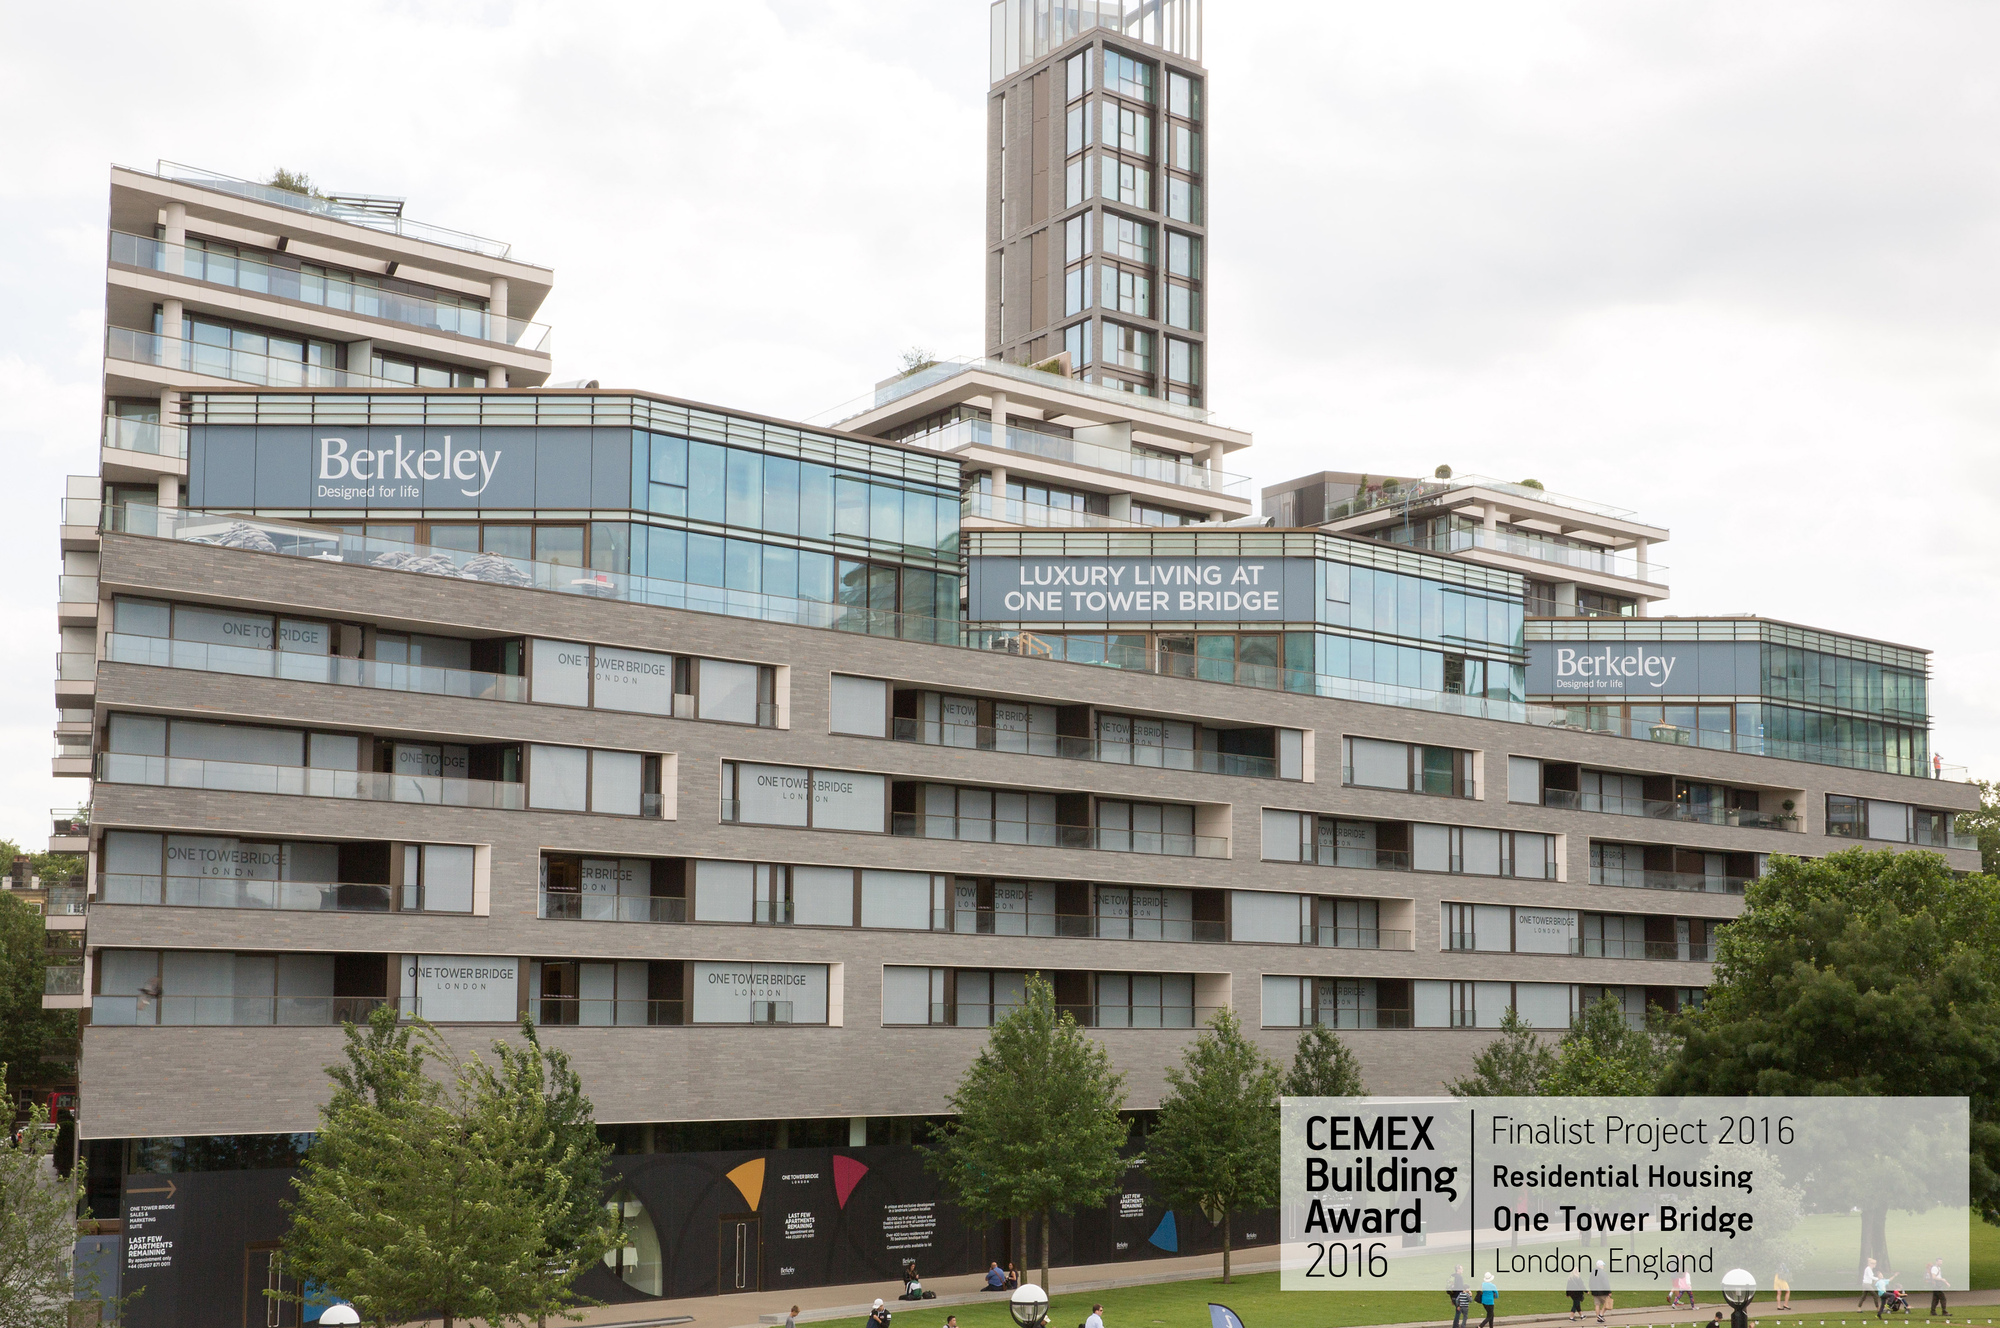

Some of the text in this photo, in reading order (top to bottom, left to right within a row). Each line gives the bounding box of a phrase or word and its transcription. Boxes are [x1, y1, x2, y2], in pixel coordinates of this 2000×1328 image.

[319, 435, 502, 497] Berkeley
[318, 485, 420, 500] Designed for life
[1020, 565, 1264, 585] LUXURY LIVING AT
[1004, 591, 1279, 611] ONE TOWER BRIDGE
[223, 622, 251, 637] ONE
[558, 653, 581, 666] ONE
[627, 661, 665, 676] BRIDGE
[1557, 646, 1676, 687] Berkeley
[1557, 679, 1623, 689] Designed for life
[400, 752, 422, 763] ONE
[757, 775, 778, 787] ONE
[818, 781, 852, 793] BRIDGE
[167, 847, 195, 860] ONE
[241, 852, 286, 865] BRIDGE
[595, 868, 632, 881] BRIDGE
[1520, 915, 1574, 926] ONE TOWER BRIDGE
[408, 967, 513, 979] ONE TOWER BRIDGE
[708, 973, 806, 985] ONE TOWER BRIDGE
[128, 1242, 173, 1250] APARTMENTS
[128, 1249, 166, 1257] REMAINING
